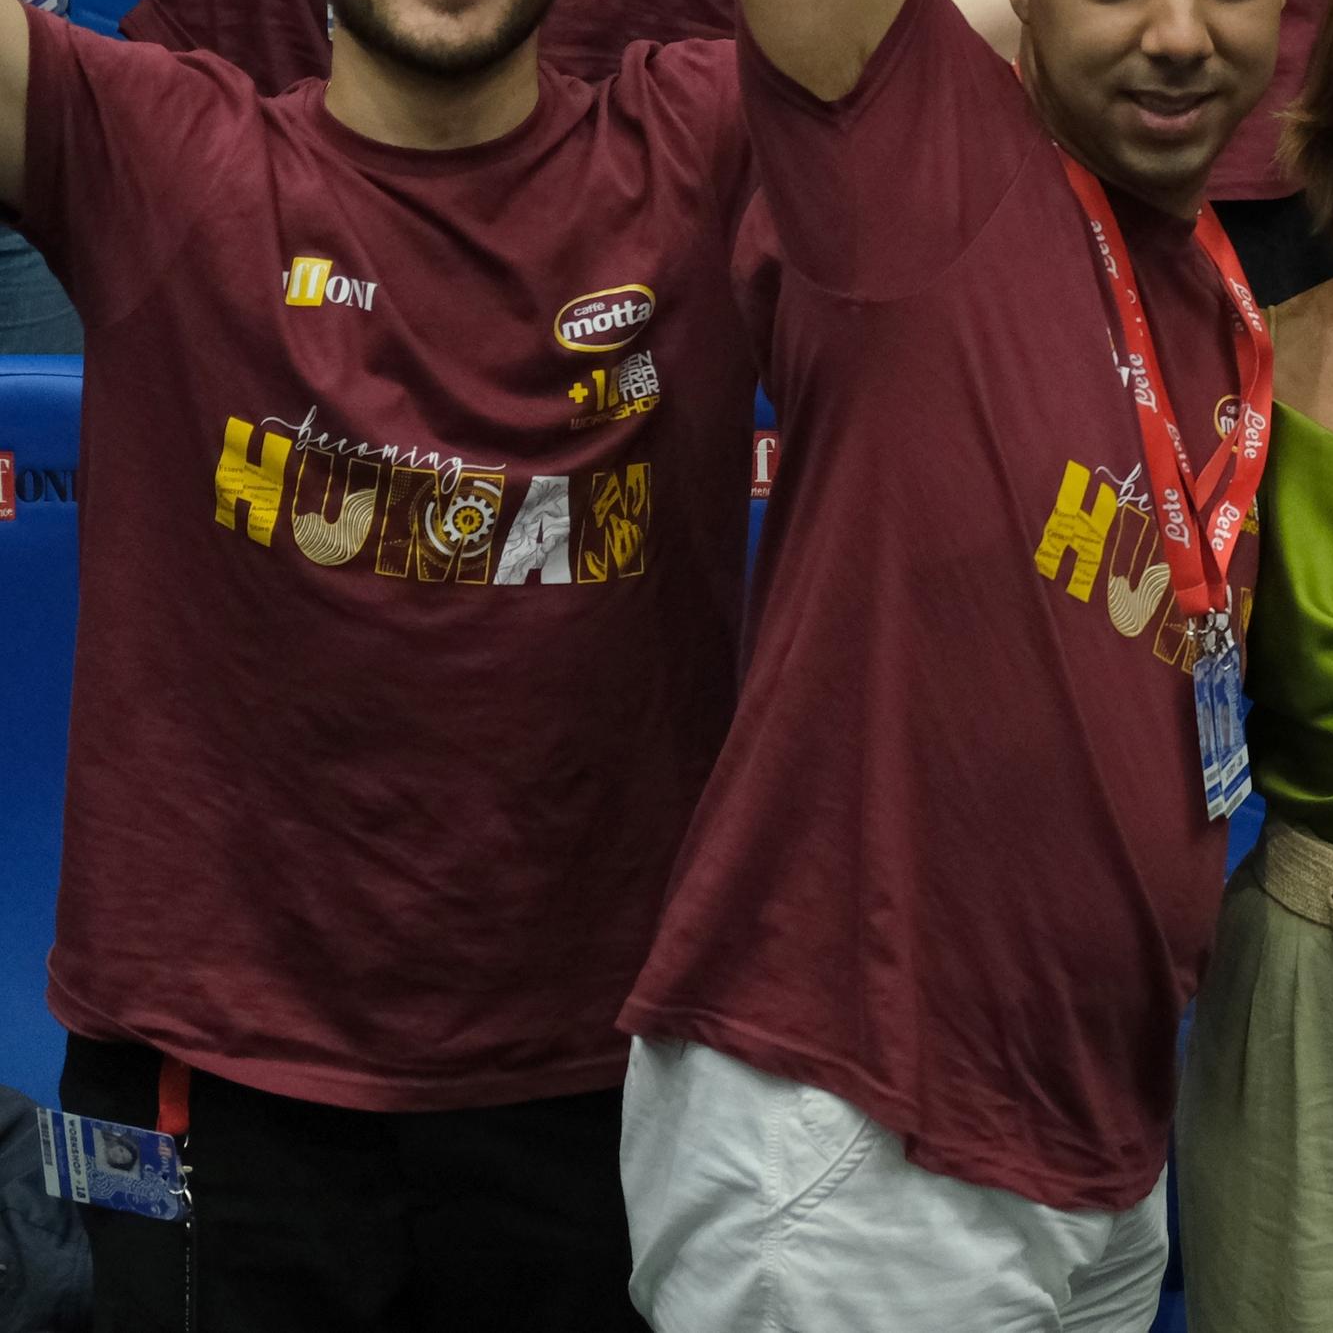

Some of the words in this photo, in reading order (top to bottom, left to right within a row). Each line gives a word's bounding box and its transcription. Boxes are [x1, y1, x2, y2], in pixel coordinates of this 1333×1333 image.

[562, 299, 652, 340] motta
[1229, 278, 1263, 332] Lete
[618, 365, 658, 388] ERA
[619, 378, 661, 402] TOR
[1129, 352, 1158, 413] Lete
[259, 404, 507, 493] becoming
[1242, 402, 1266, 460] Lete
[214, 416, 651, 585] HUMAN
[1162, 487, 1191, 549] Lete
[1211, 500, 1241, 552] Lete
[68, 1118, 81, 1177] WORKSHOP
